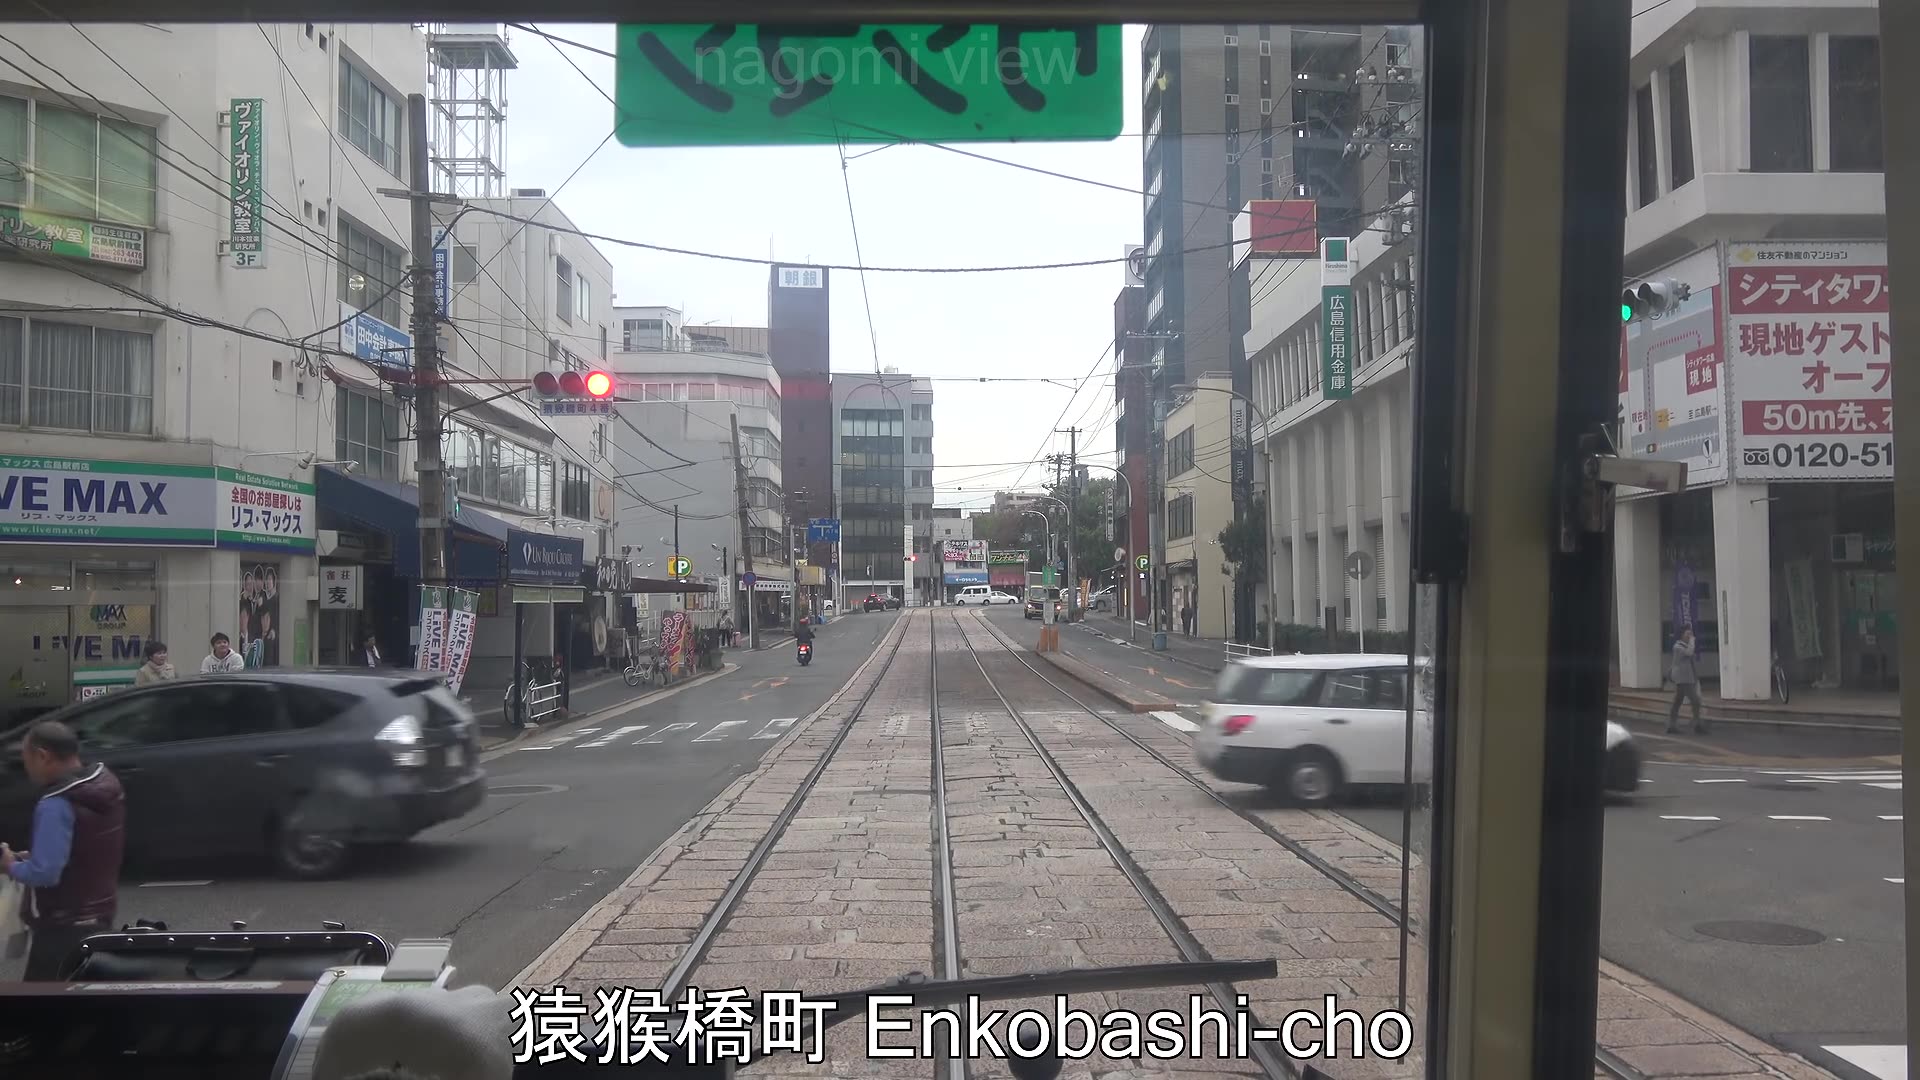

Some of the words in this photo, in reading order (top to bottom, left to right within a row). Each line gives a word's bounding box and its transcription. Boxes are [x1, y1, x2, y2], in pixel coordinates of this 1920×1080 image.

[234, 101, 252, 233] ヴァイオリン教室
[236, 252, 256, 266] 3F
[1757, 251, 1848, 260] 住友不動産のマンション
[785, 270, 817, 286] 朝銀
[1330, 295, 1346, 390] 広島信用金庫
[1739, 321, 1890, 356] 現地ゲスト
[1689, 370, 1713, 387] 現地
[43, 461, 90, 471] 広島駅前店
[63, 478, 168, 515] MAX
[231, 486, 302, 511] 全国のお部屋探しは
[21, 512, 97, 521] リブ・マックス
[231, 505, 302, 534] リブ・マックス
[677, 561, 688, 574] P
[328, 586, 347, 604] 麦
